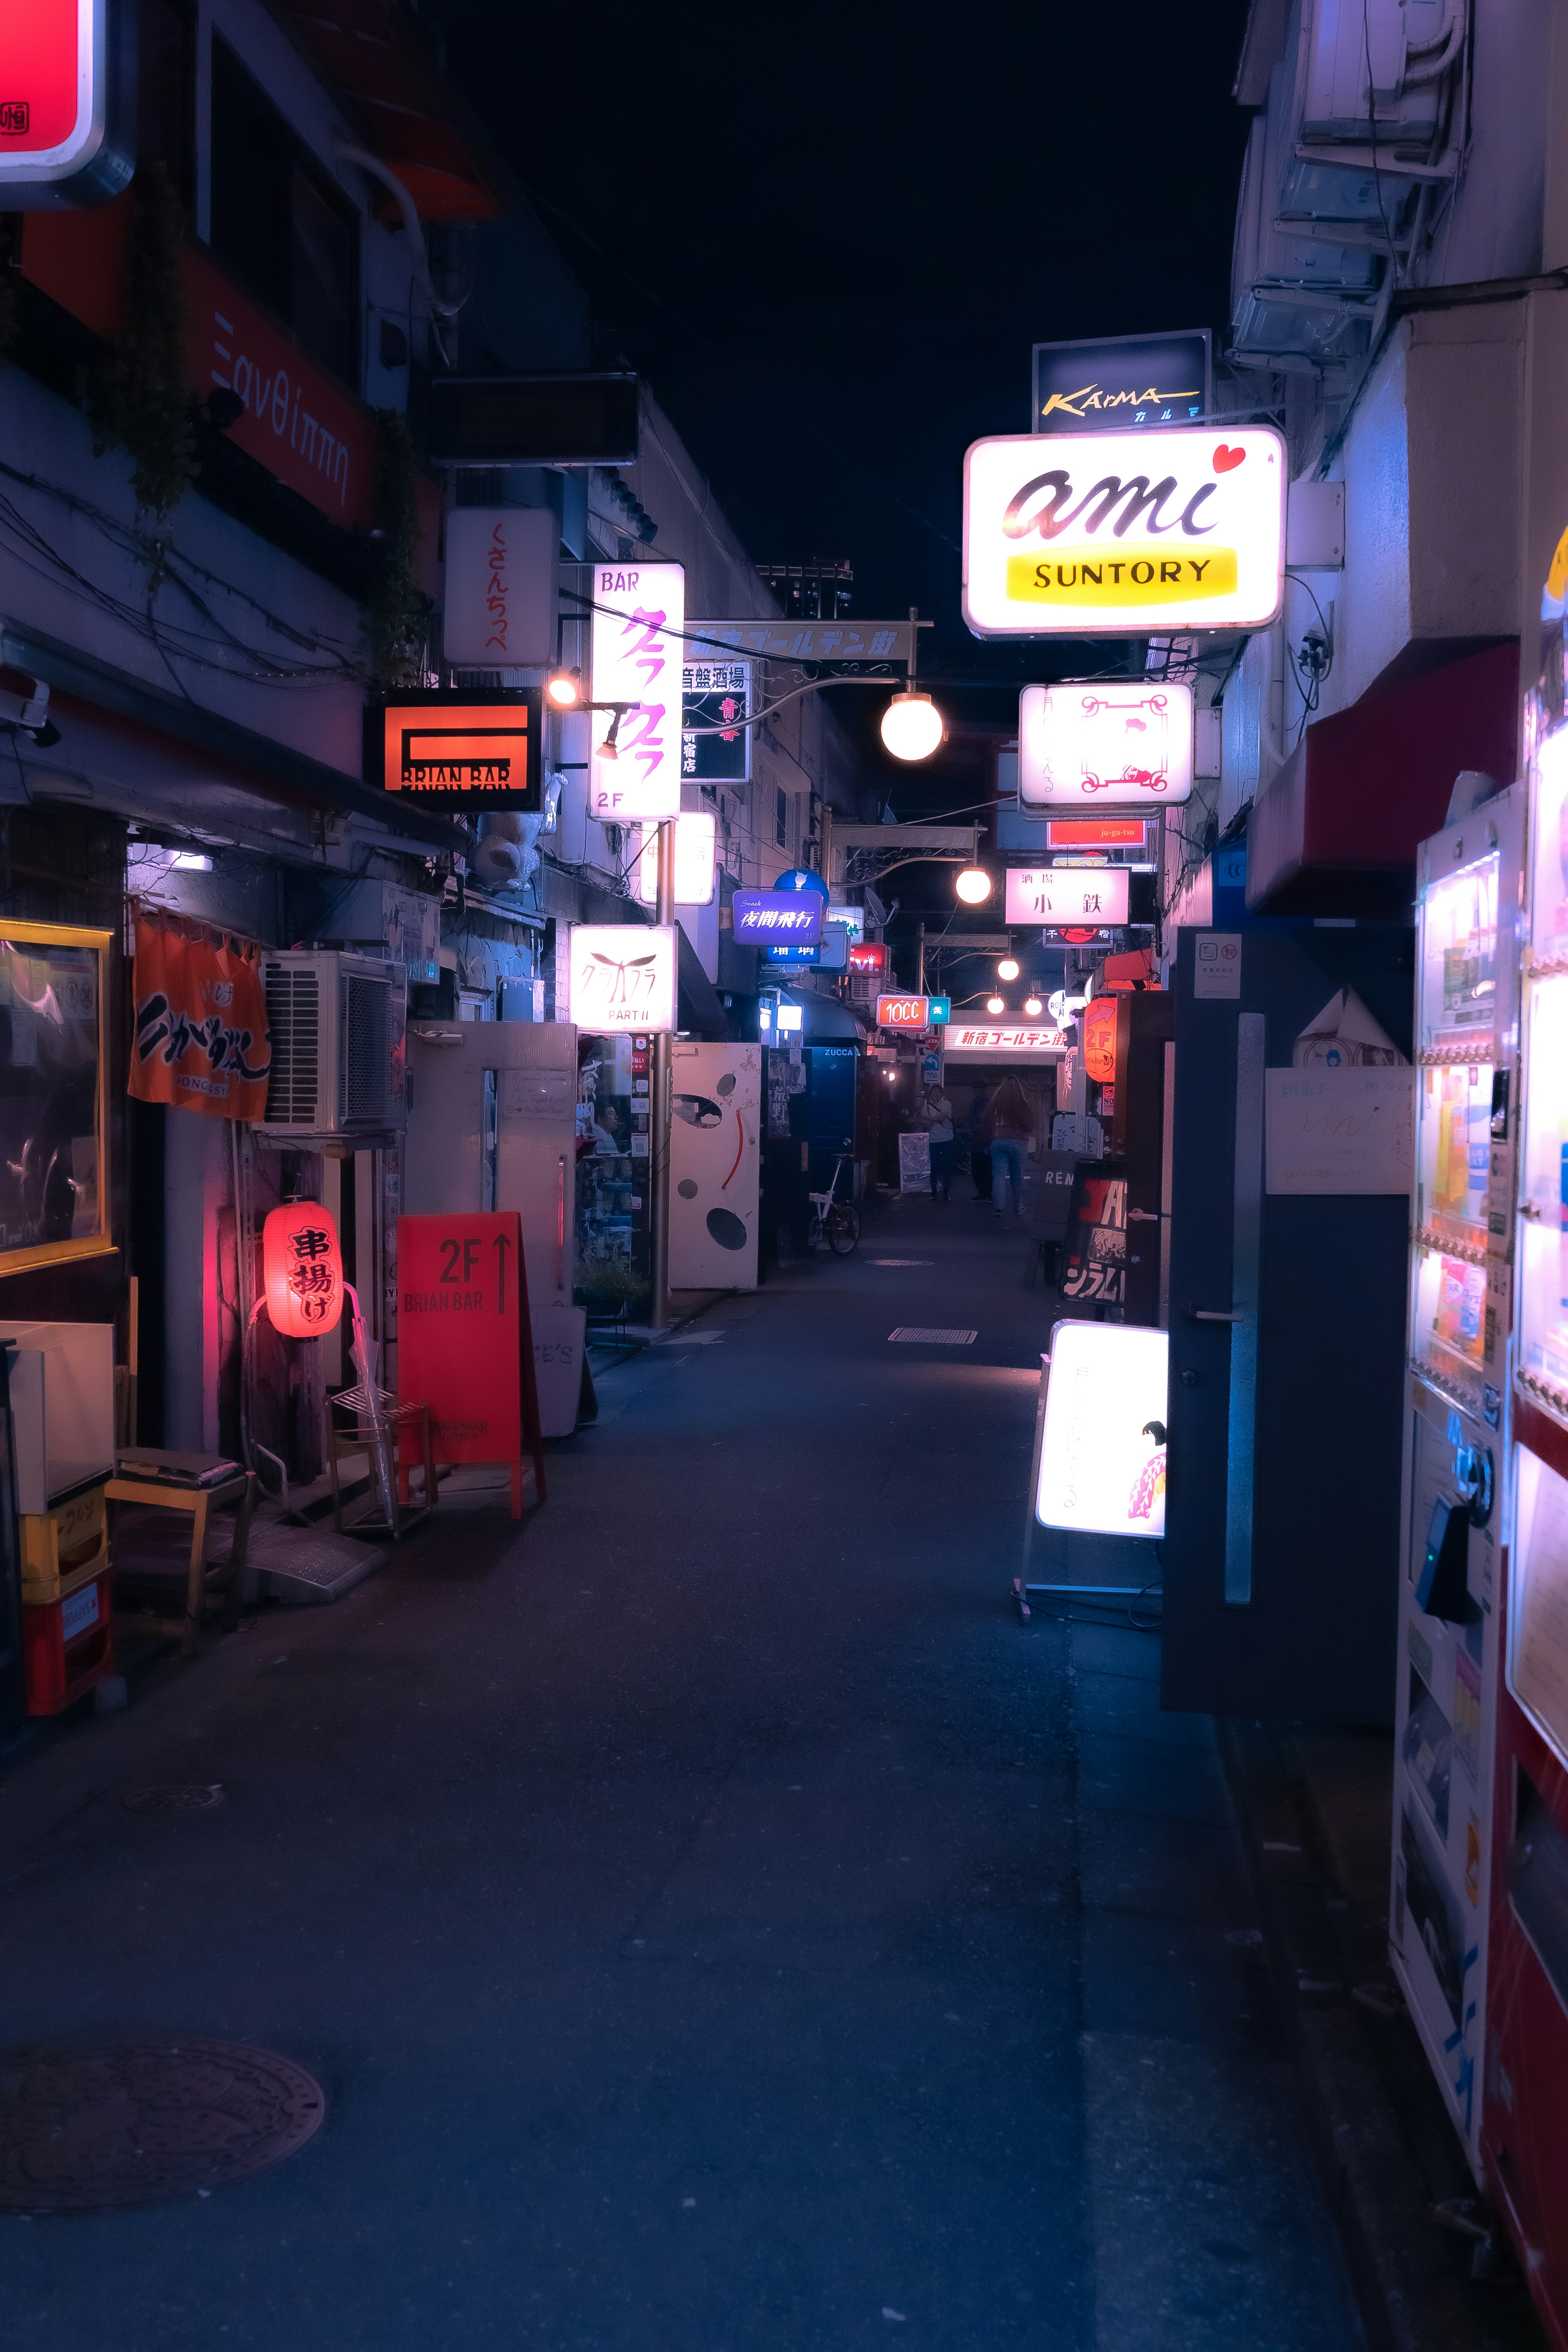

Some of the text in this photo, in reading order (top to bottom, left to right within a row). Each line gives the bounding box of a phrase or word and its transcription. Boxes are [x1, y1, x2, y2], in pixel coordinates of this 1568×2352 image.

[1002, 463, 1220, 540] ami
[601, 572, 639, 592] BAR
[1033, 559, 1212, 588] SUNTORY
[485, 523, 509, 652] くさんちっぺ
[682, 667, 744, 689] 音盤酒場
[719, 697, 740, 742] 青春
[401, 767, 511, 790] BRIAN BAR
[598, 792, 624, 808] 2F
[1100, 829, 1135, 838] ju-ga-tsu
[1022, 874, 1053, 884] 酒場
[1034, 894, 1102, 913] 小鉄
[739, 910, 815, 928] 夜間飛行
[608, 1010, 640, 1020] PART
[885, 1002, 920, 1024] 10CC
[961, 1031, 1067, 1047] 新宿ゴールデン街
[1086, 1029, 1111, 1048] 2F
[439, 1238, 483, 1284] 2F
[292, 1229, 334, 1322] 串揚げ
[404, 1292, 450, 1312] BRIAN
[452, 1291, 483, 1311] BAR
